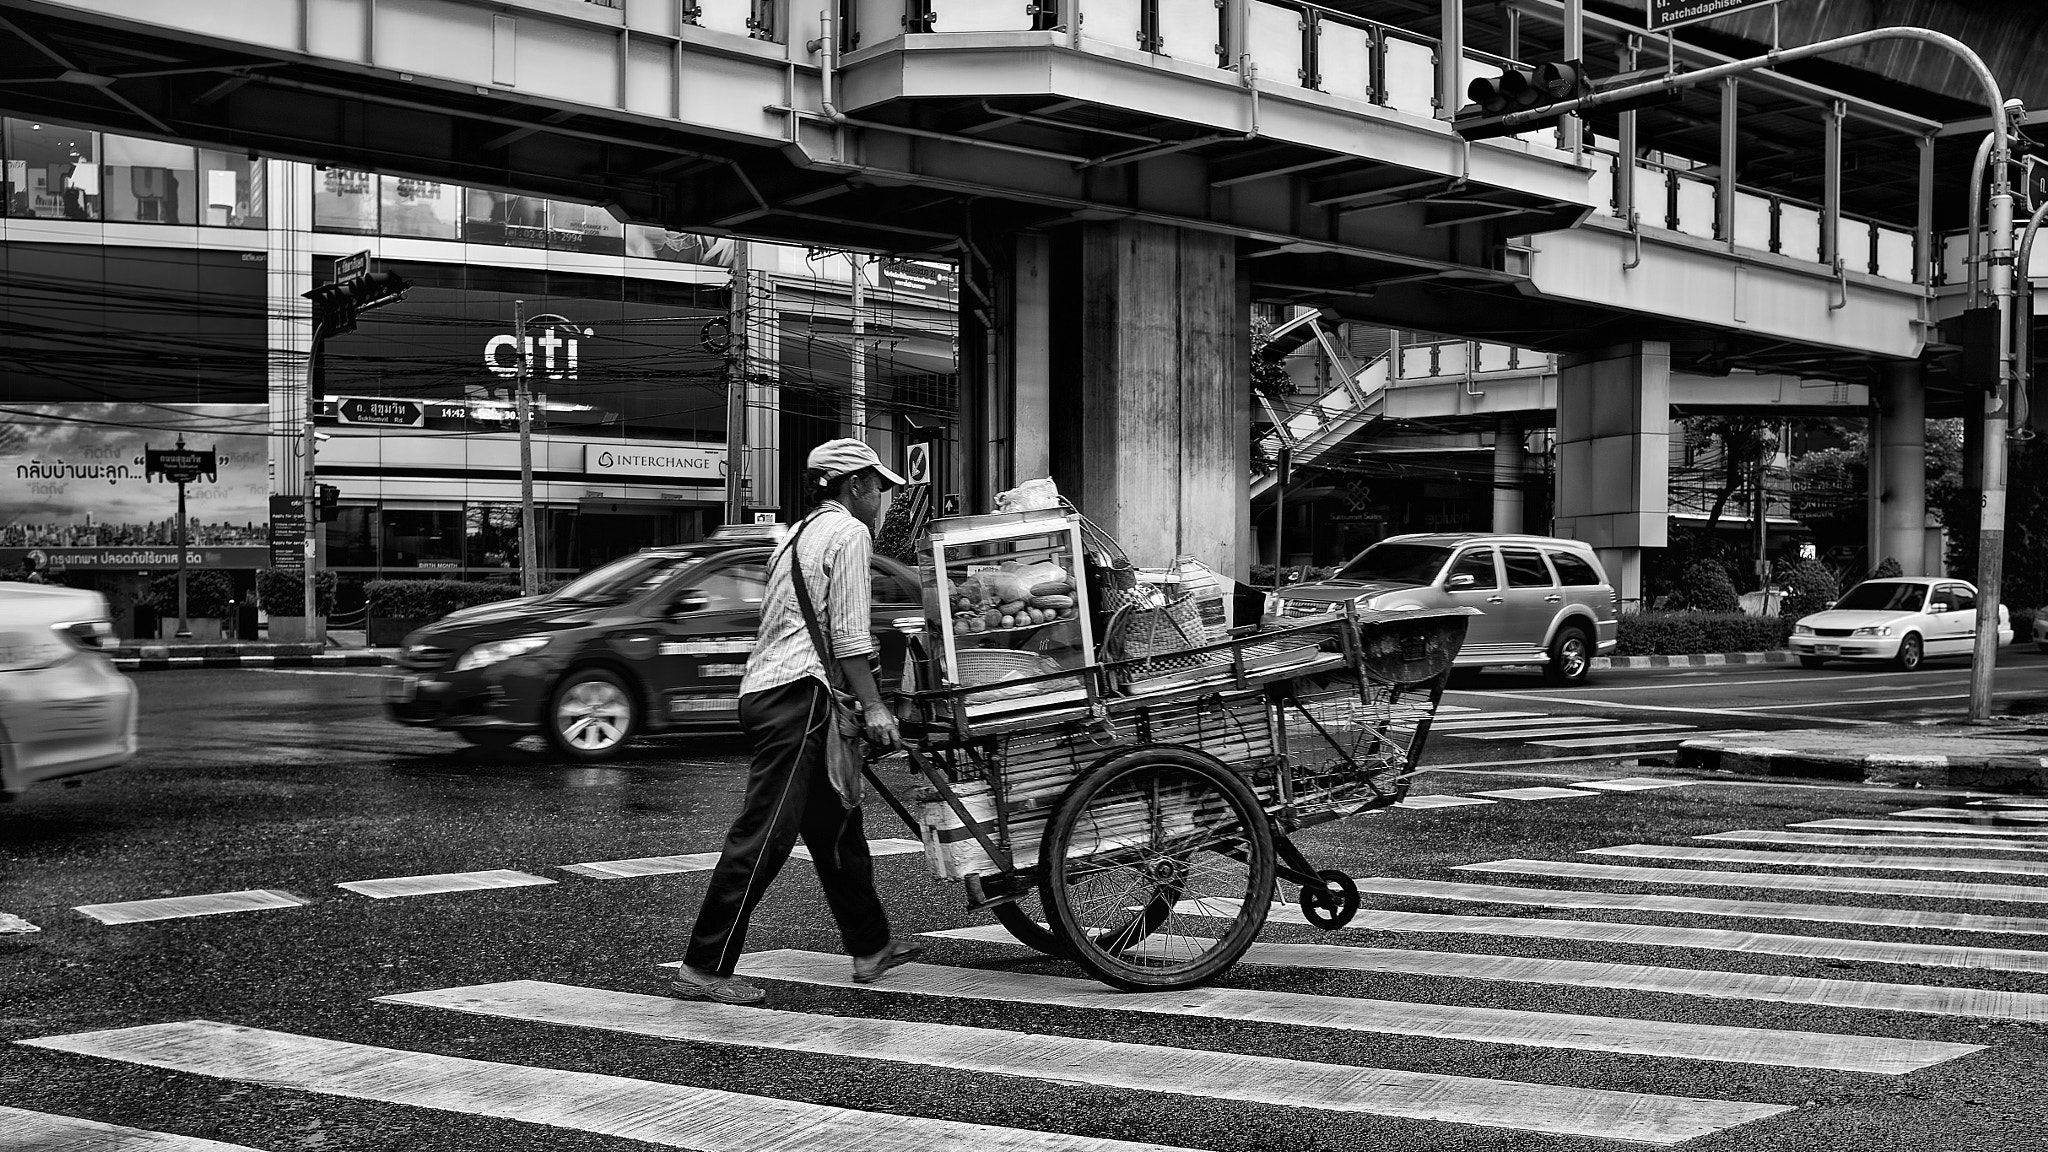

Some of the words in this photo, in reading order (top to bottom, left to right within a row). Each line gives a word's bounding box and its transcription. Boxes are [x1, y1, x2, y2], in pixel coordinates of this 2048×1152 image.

[371, 402, 405, 416] สุขุมวิท
[617, 455, 710, 470] INTERCHANGE
[100, 551, 203, 565] ปลอดภัยไร้ยาเสติด
